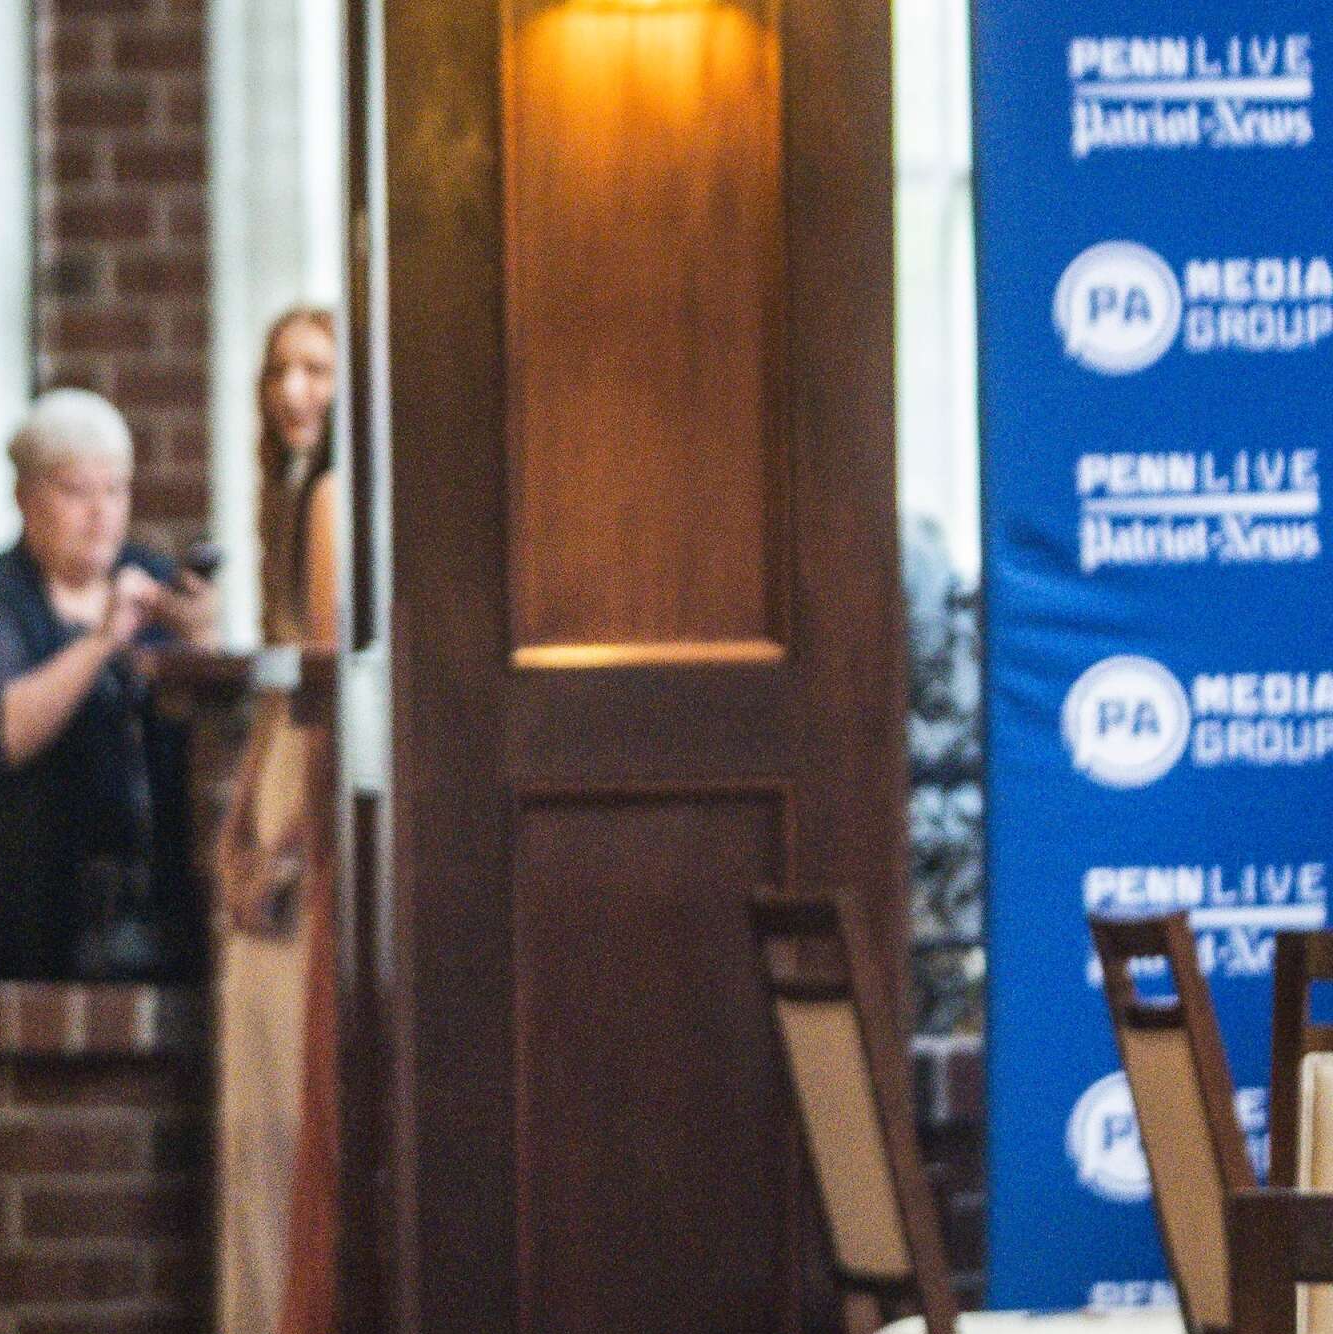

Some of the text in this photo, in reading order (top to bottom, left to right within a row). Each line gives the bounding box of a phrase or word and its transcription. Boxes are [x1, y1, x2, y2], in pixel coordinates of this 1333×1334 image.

[1186, 256, 1333, 298] MEDIA
[1088, 286, 1153, 325] PA
[1186, 304, 1333, 351] GROUP
[1193, 672, 1333, 713] MEDIA
[1097, 699, 1162, 738] PA
